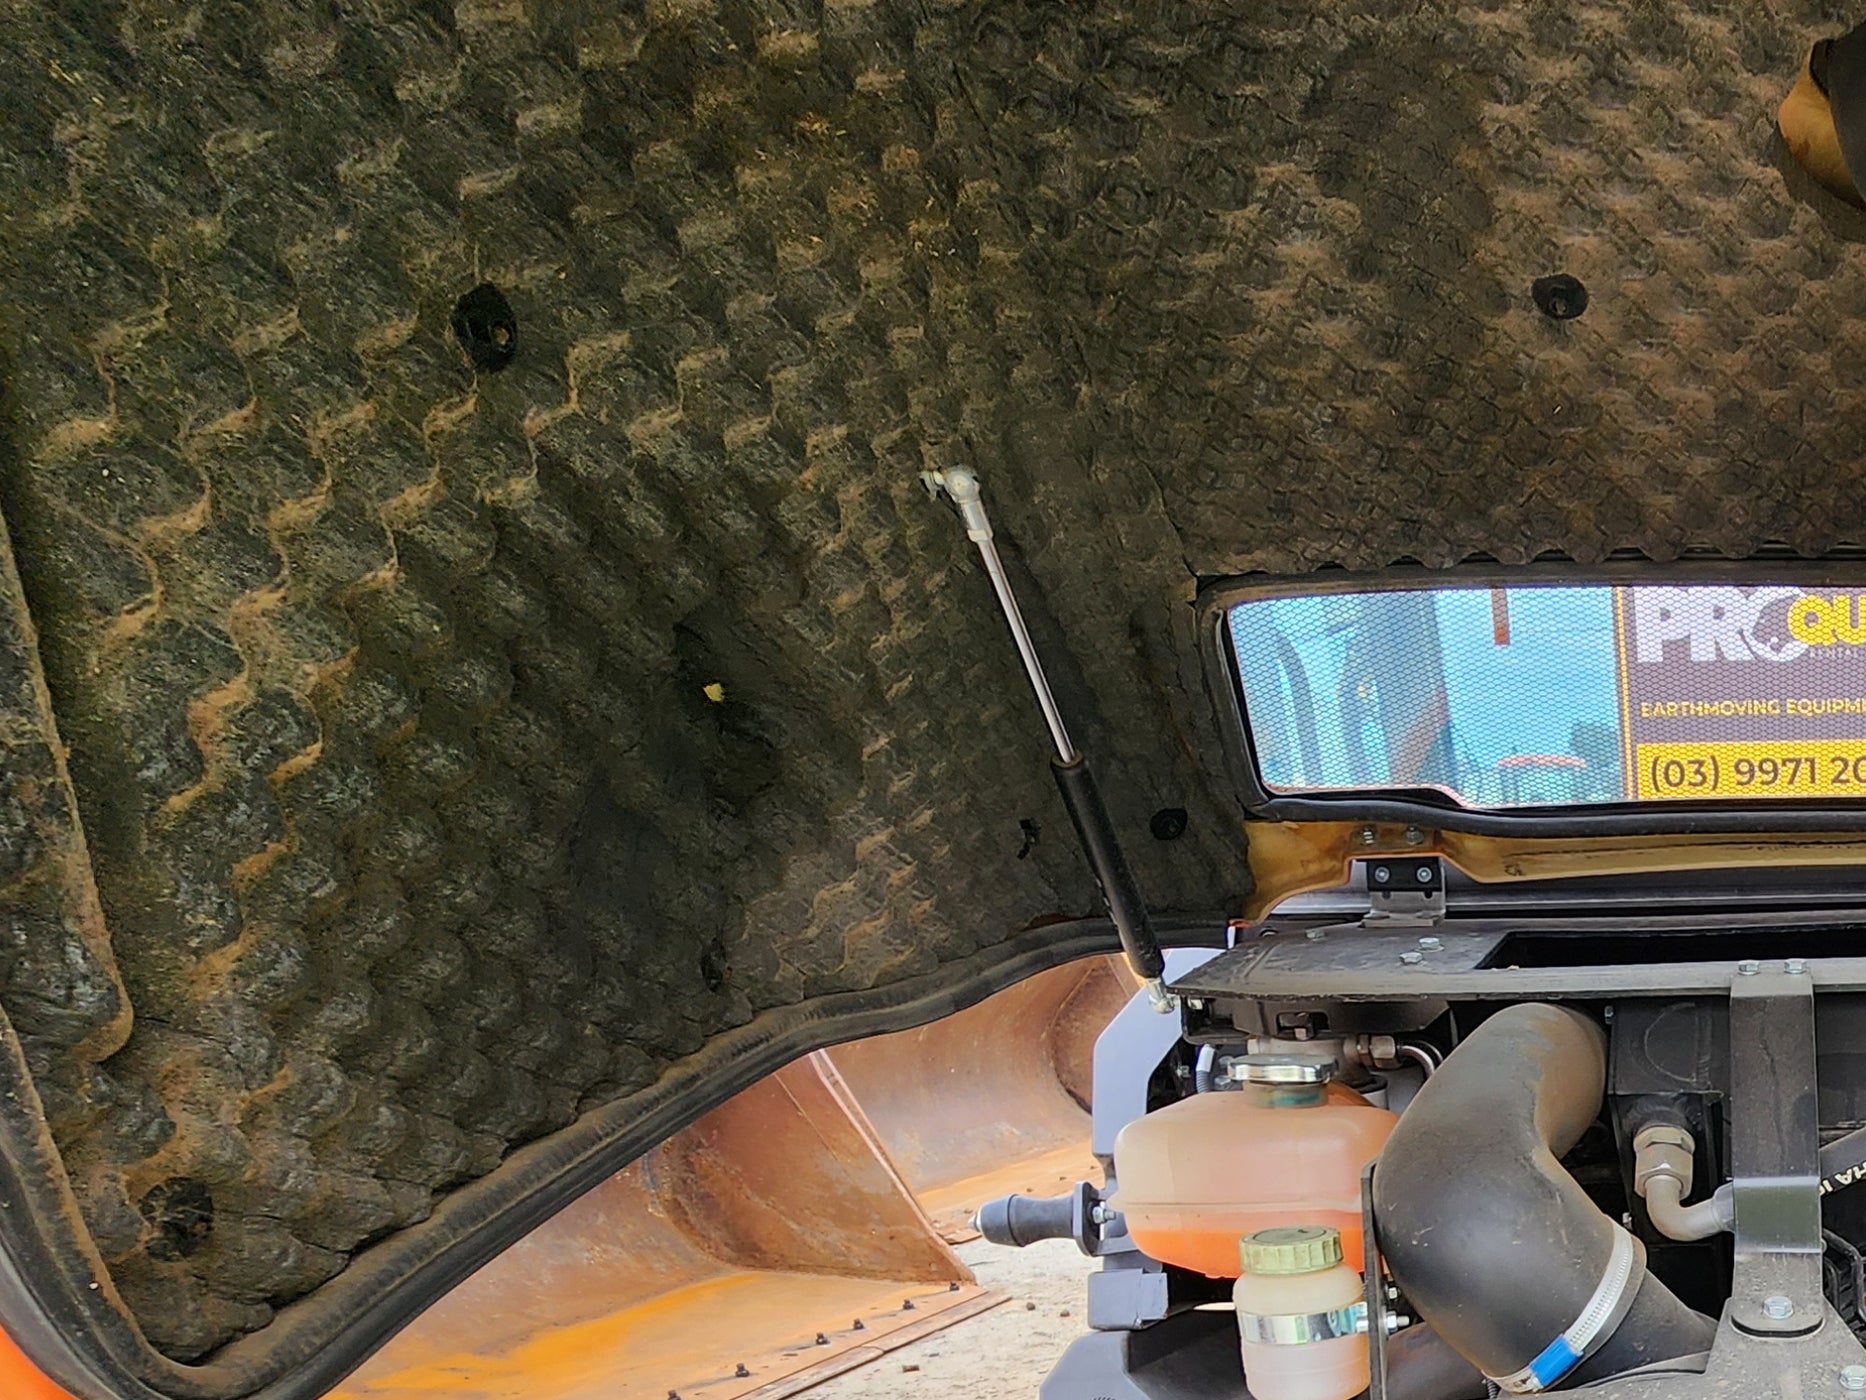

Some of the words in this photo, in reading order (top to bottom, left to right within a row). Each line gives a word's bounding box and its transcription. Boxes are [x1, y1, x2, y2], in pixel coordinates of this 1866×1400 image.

[1640, 699, 1782, 718] EARTHMOVING
[1651, 754, 1720, 793] (03)
[1733, 756, 1817, 786] 9971
